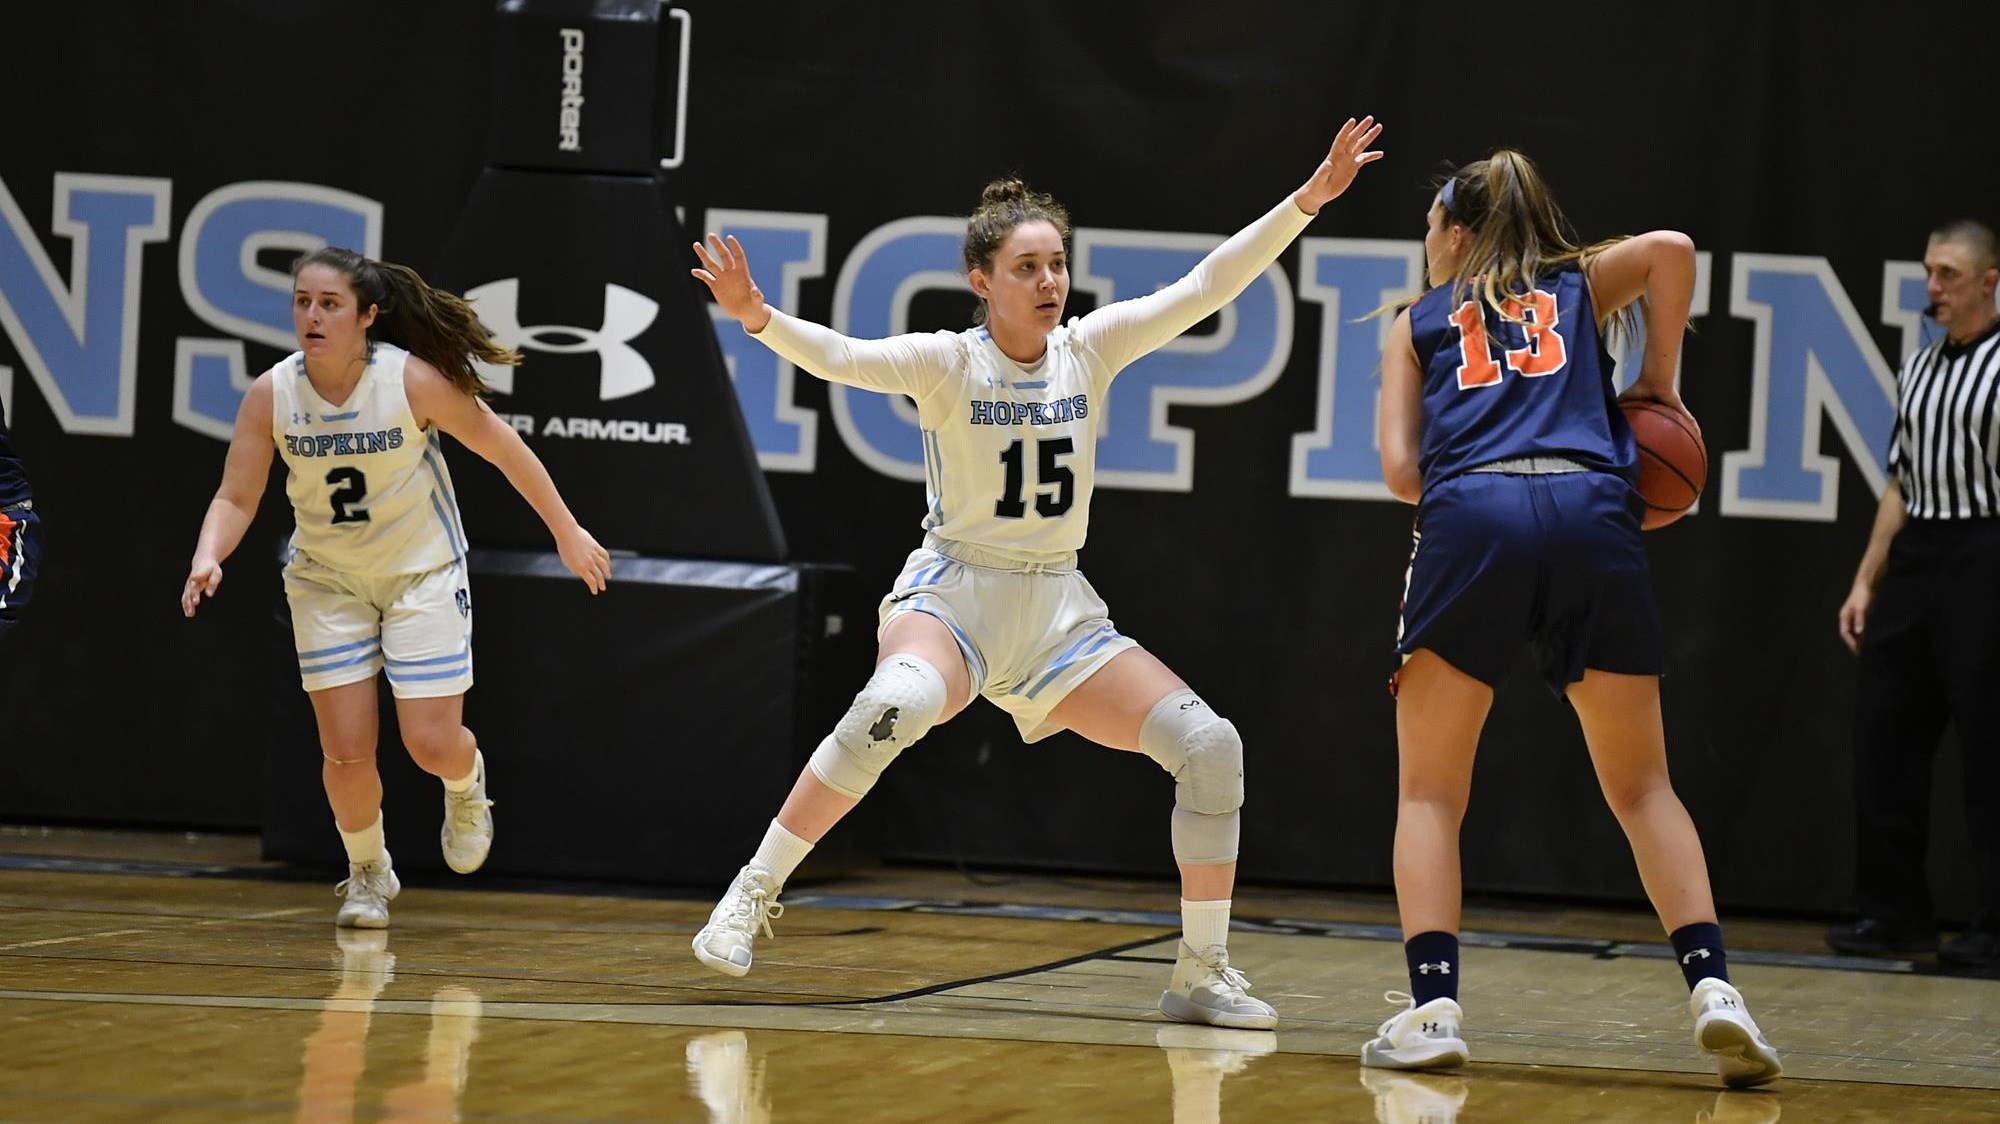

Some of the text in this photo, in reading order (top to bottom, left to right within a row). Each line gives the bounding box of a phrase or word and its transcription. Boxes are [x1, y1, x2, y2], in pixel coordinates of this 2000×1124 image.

[0, 171, 383, 442] NS
[1448, 289, 1567, 391] 13
[542, 416, 688, 445] ARMOUR
[970, 394, 1089, 425] HOPKINS
[284, 427, 404, 457] HOPKINS
[325, 466, 371, 525] 2
[993, 436, 1075, 518] 15
